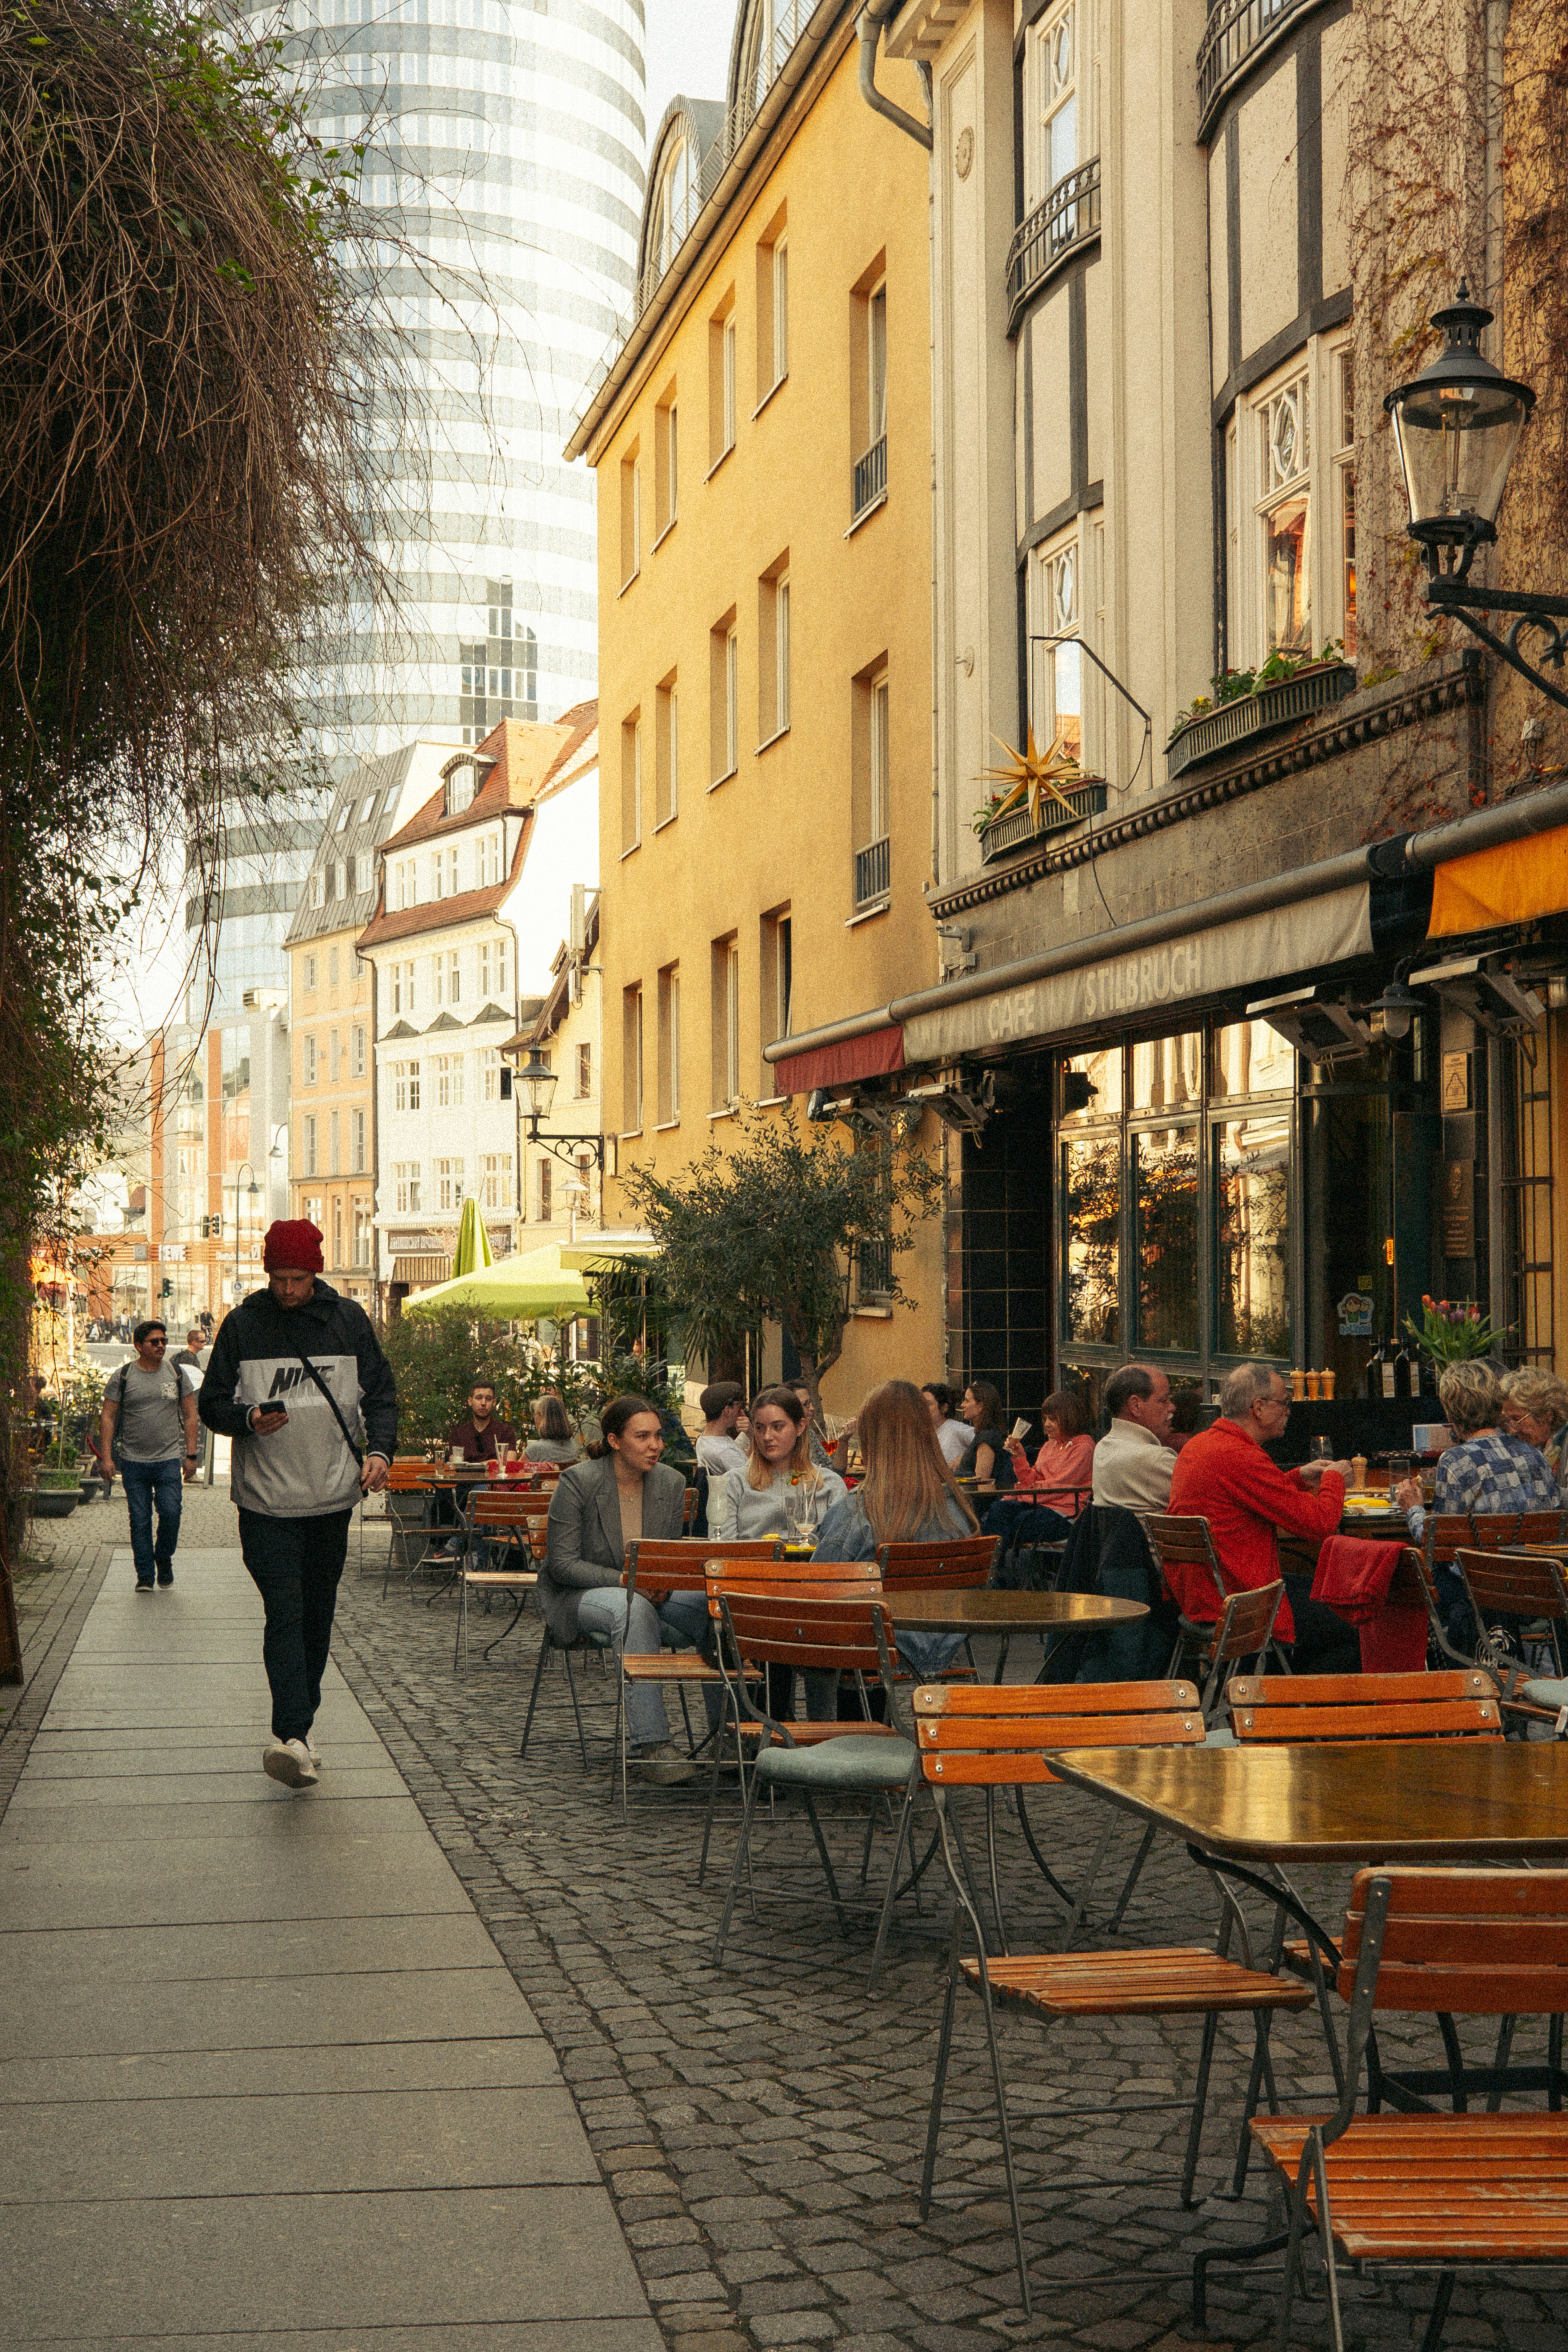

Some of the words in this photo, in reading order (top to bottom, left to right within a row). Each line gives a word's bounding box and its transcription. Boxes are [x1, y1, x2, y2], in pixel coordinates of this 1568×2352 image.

[988, 988, 1035, 1040] CAFE
[1085, 940, 1201, 1016] STILBRUCH
[268, 1365, 335, 1400] NIKE
